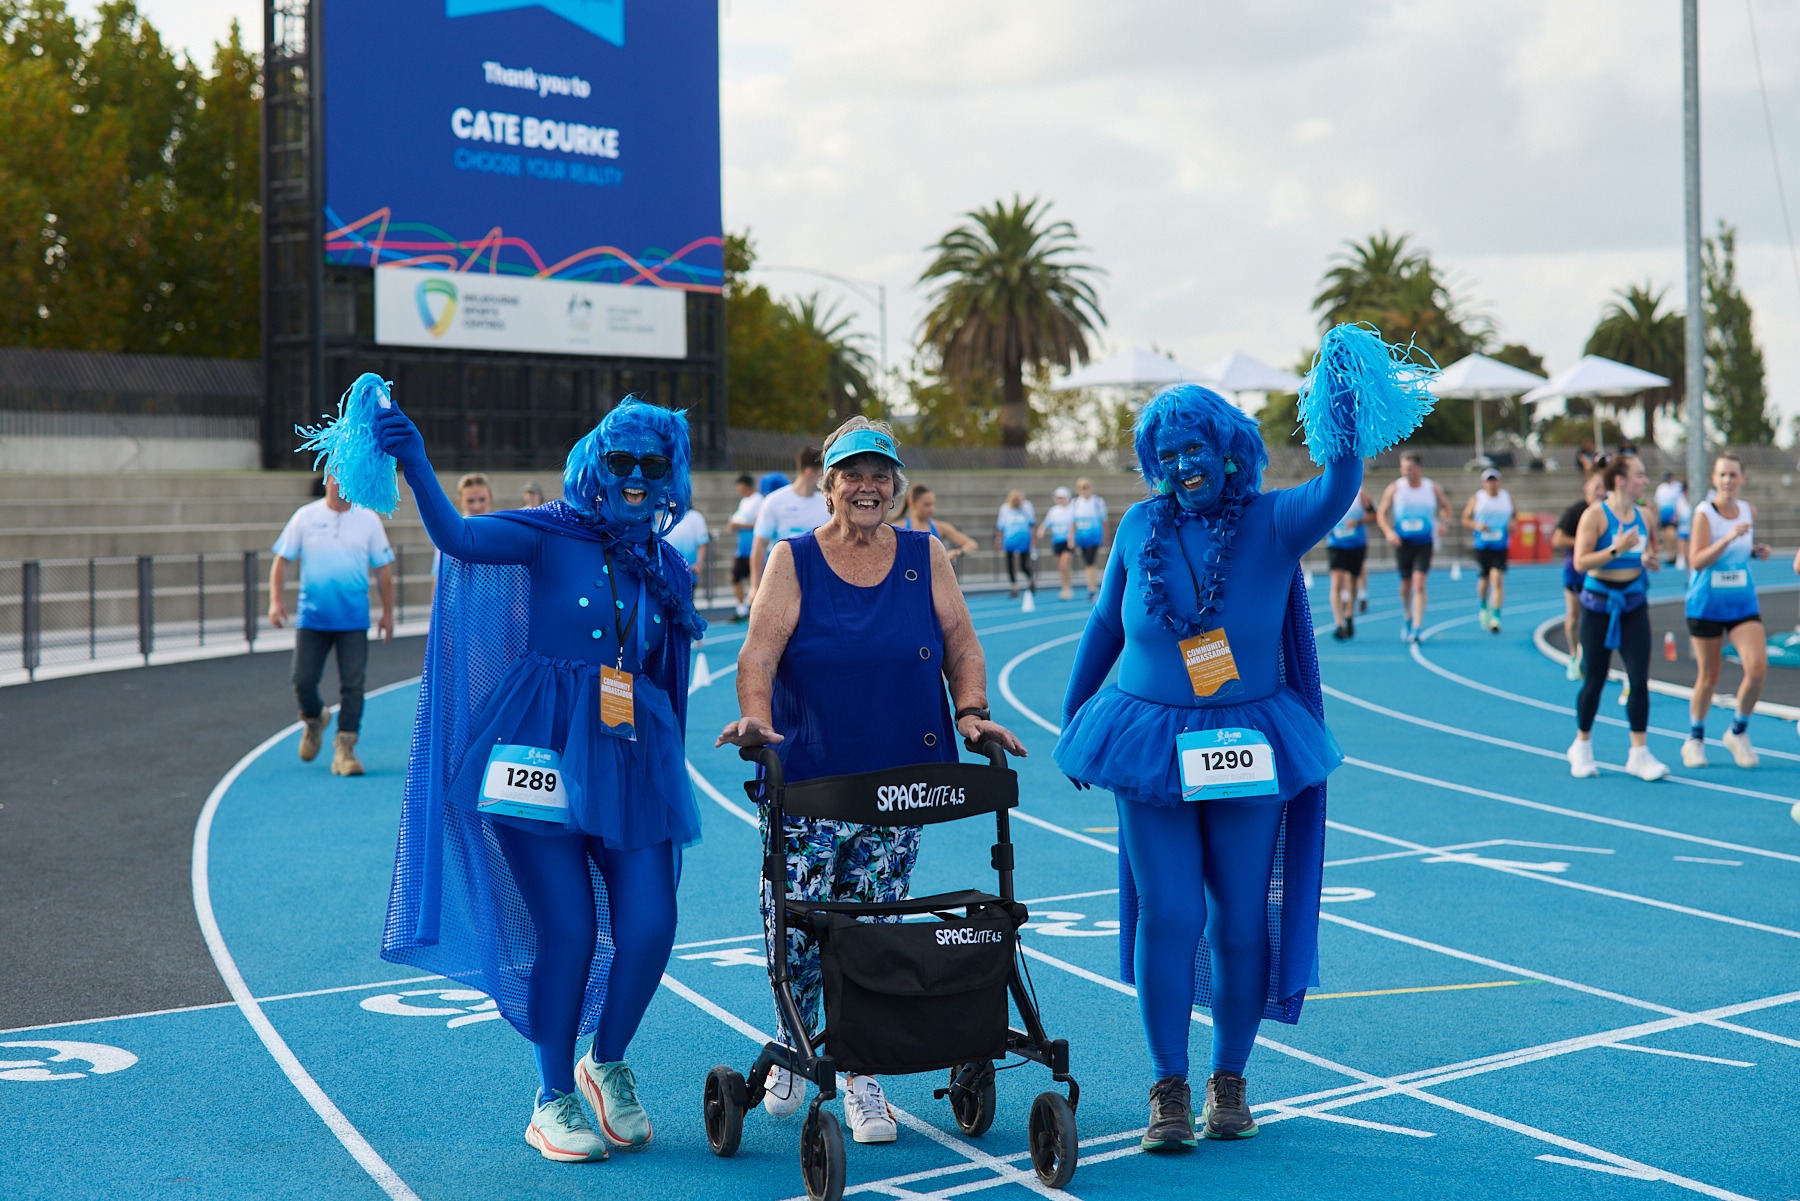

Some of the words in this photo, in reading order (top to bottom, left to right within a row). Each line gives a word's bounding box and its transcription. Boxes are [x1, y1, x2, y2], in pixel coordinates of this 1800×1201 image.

[482, 60, 538, 91] Thank
[538, 73, 571, 98] you
[571, 76, 591, 98] to
[451, 107, 521, 146] CATE
[522, 116, 620, 159] BOURKE
[454, 147, 521, 177] CHOOSE
[525, 156, 567, 180] YOUR
[1186, 640, 1225, 658] COMMUNITY
[1186, 646, 1231, 667] AMBASSADOR
[1201, 749, 1254, 771] 1290
[507, 767, 557, 792] 1289
